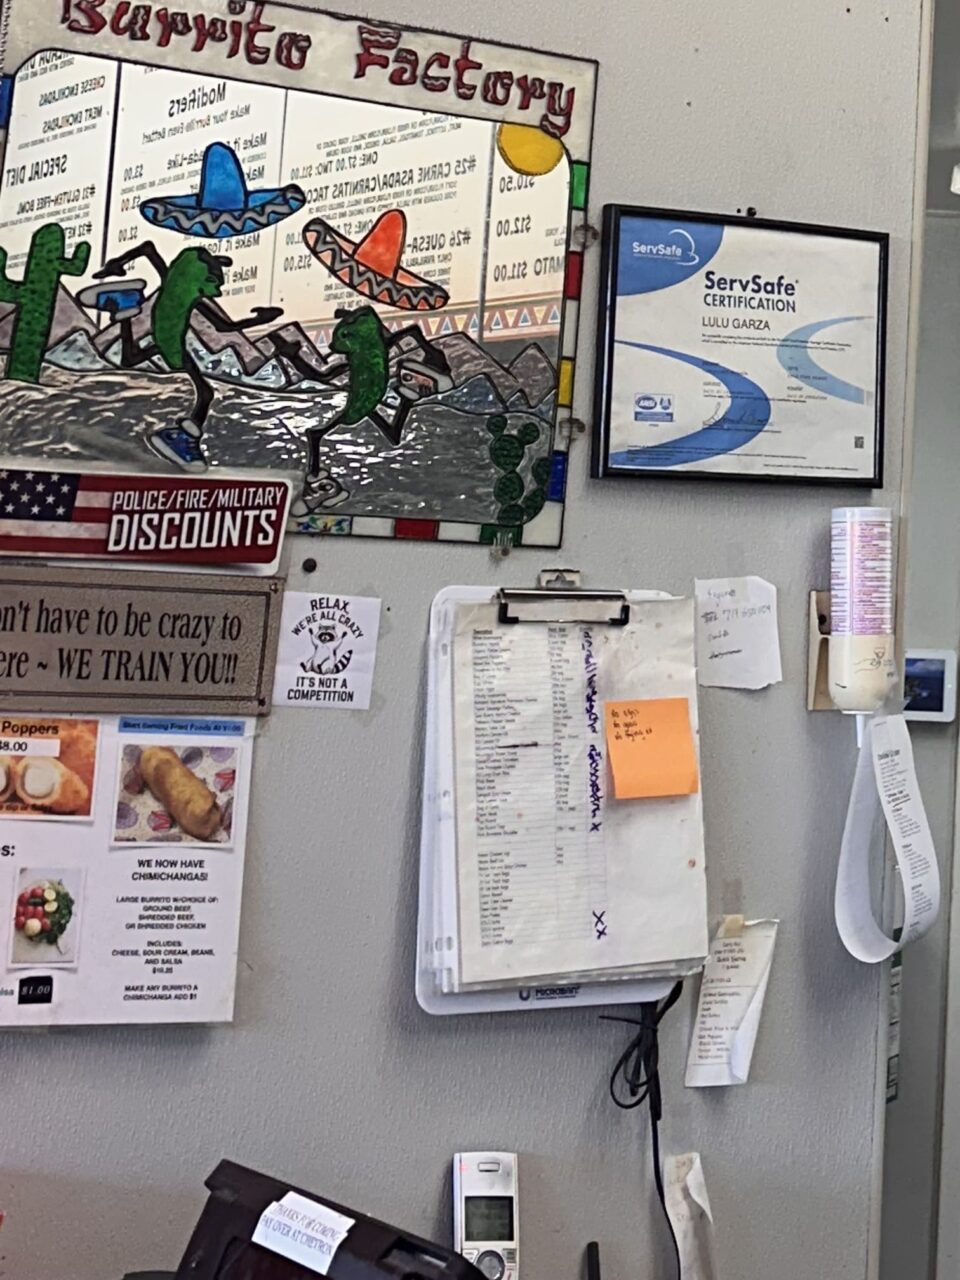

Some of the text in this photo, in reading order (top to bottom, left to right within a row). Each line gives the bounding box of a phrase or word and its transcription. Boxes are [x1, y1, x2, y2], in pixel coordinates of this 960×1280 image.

[355, 21, 575, 136] Factory
[632, 241, 682, 257] ServSafe
[704, 271, 796, 296] ServSafe
[704, 293, 796, 313] CERTIFICATION
[702, 317, 770, 332] LULU GARZA
[112, 487, 284, 511] POLICE/FIRE/MILITARY
[107, 509, 277, 552] DISCOUNTS
[0, 599, 241, 645] n't have to be crazy to
[319, 610, 338, 623] ALL
[338, 612, 364, 639] CRAZY
[58, 648, 93, 680] WE
[101, 649, 173, 682] TRAIN
[181, 652, 239, 685] YOU!!
[296, 676, 348, 689] IT'S NOT A
[287, 689, 354, 702] COMPETITION
[1, 721, 59, 736] Poppers
[138, 859, 205, 868] WE NOW HAVE
